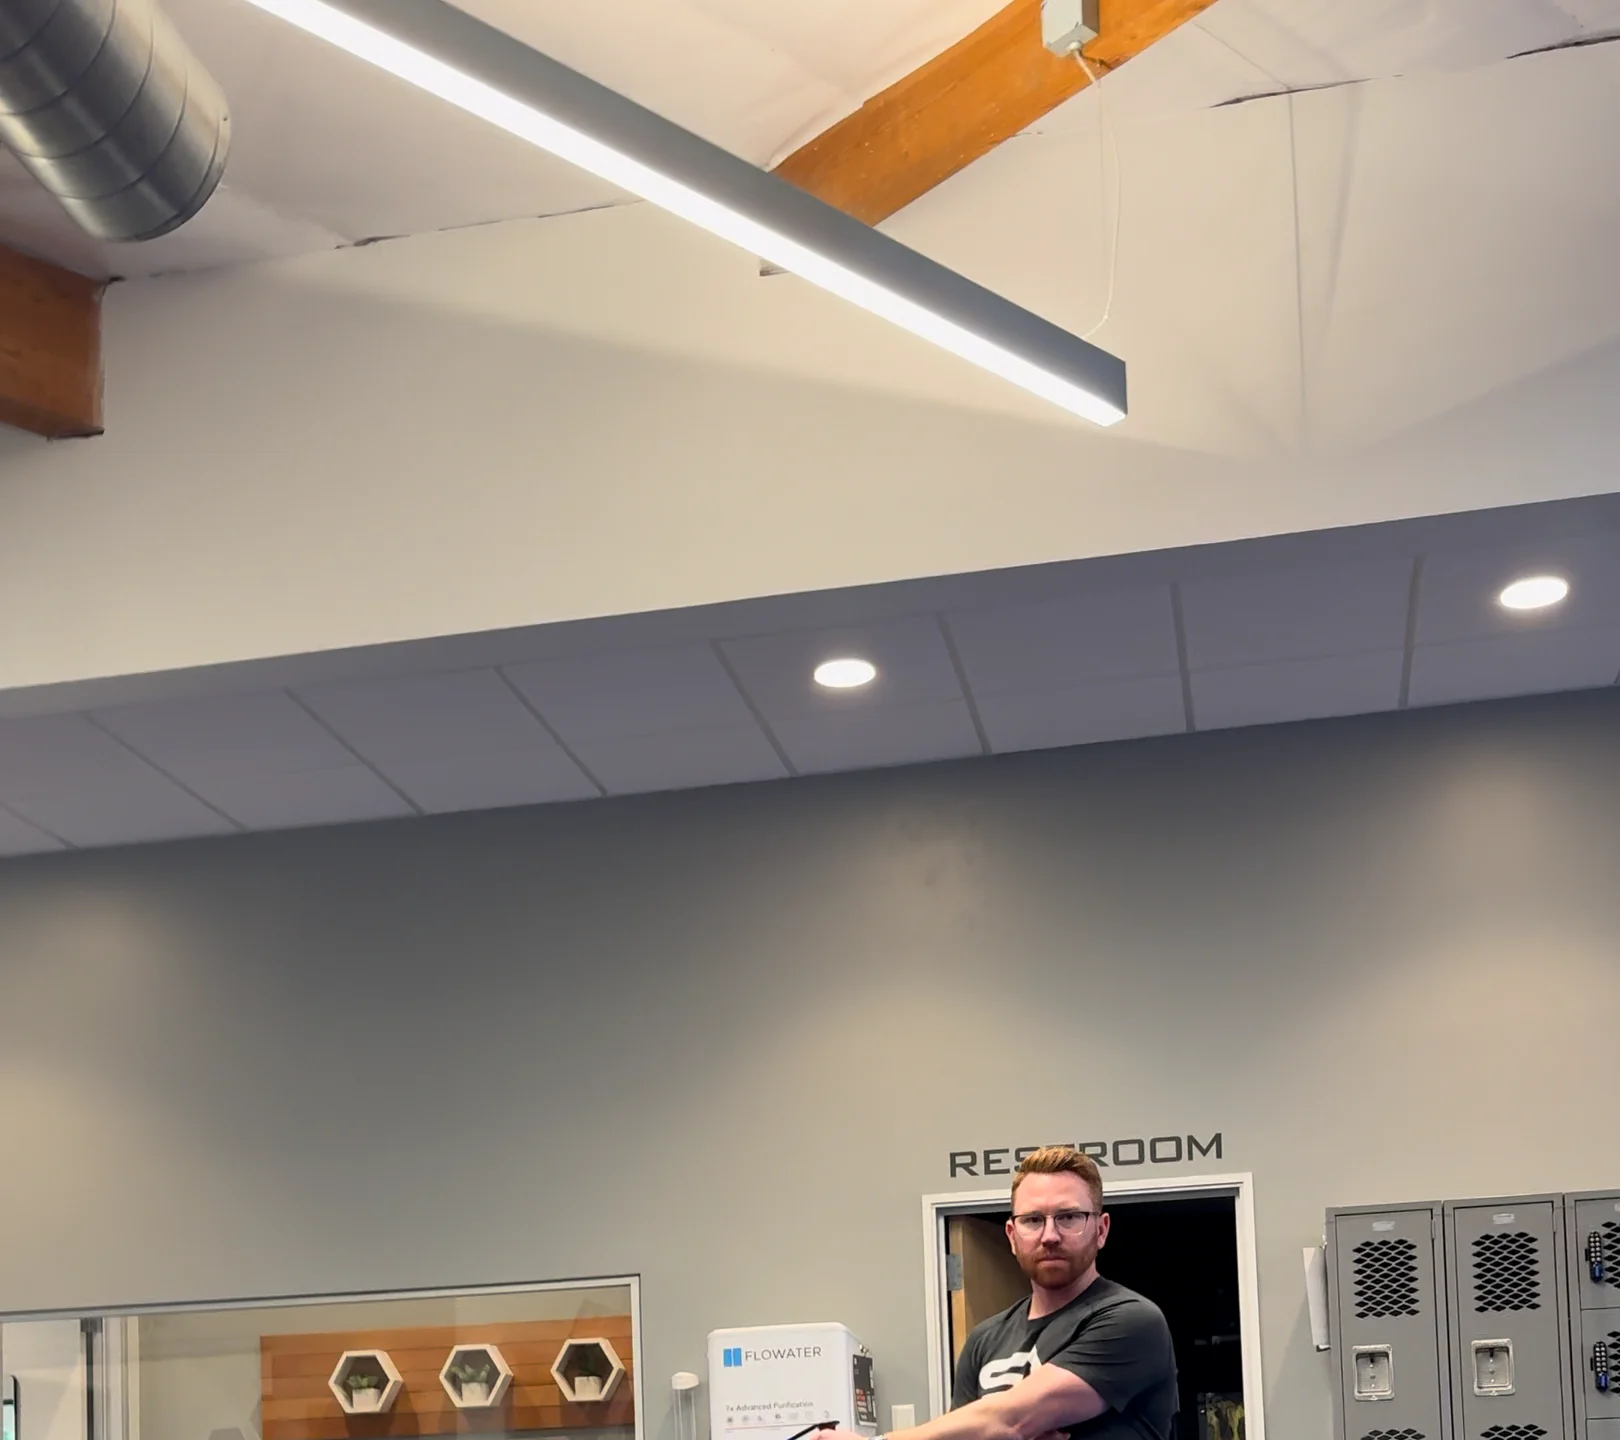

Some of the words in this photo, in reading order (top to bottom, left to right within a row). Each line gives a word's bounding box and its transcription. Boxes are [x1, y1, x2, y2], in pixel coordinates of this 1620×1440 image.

[950, 1132, 1223, 1178] RESROOM
[745, 1346, 822, 1361] FLOWATER
[736, 1403, 773, 1412] Advanced
[773, 1400, 814, 1410] Purification
